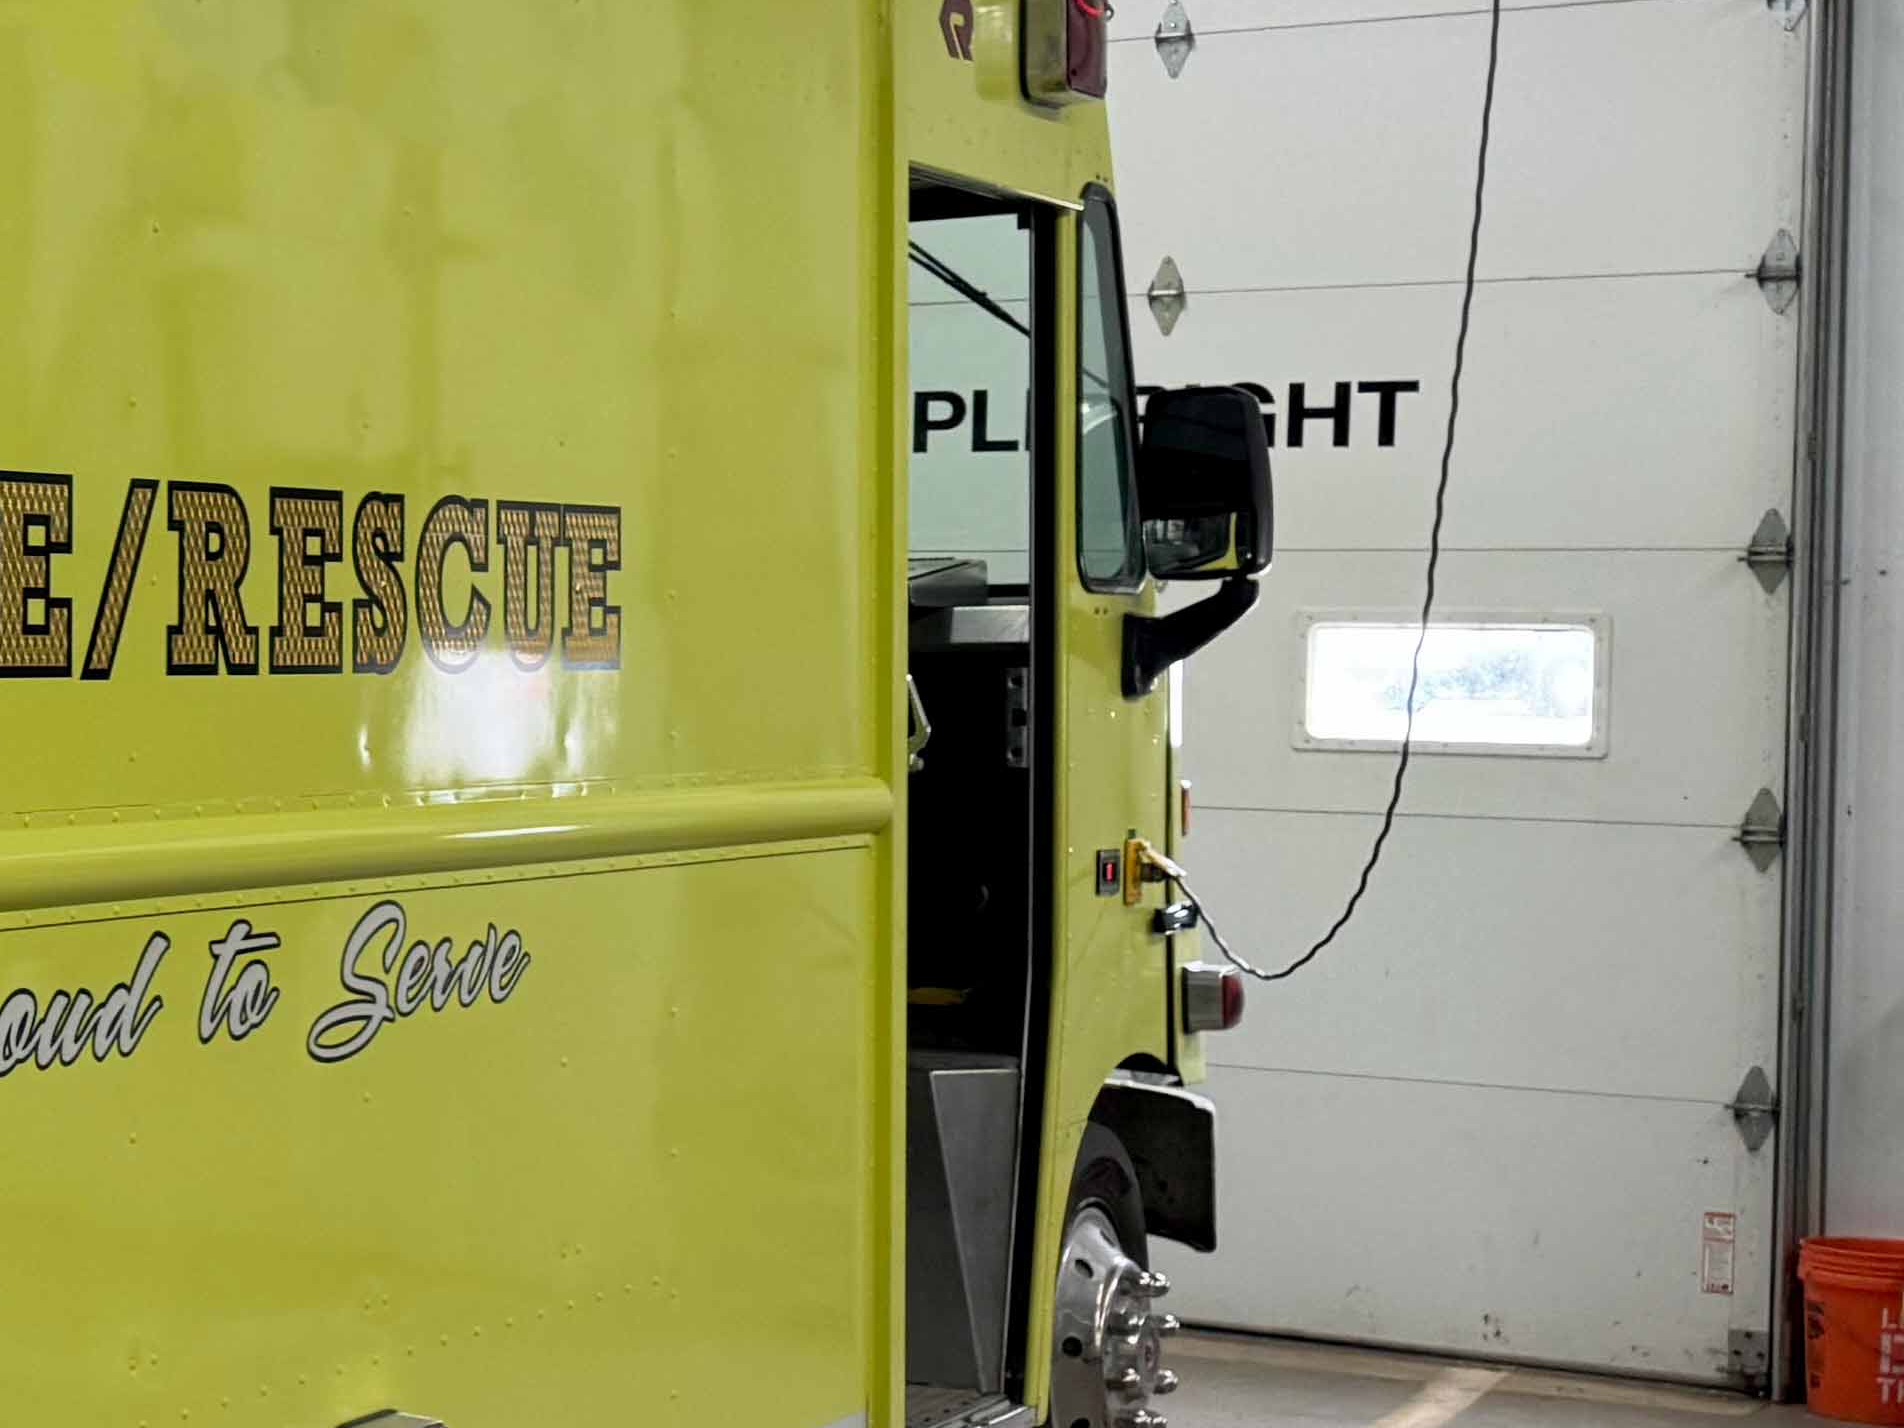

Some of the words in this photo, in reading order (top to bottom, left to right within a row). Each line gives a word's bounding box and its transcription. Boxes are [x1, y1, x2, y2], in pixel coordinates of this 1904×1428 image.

[912, 388, 1031, 453] PL
[197, 919, 281, 1045] to
[307, 900, 531, 1063] Serve
